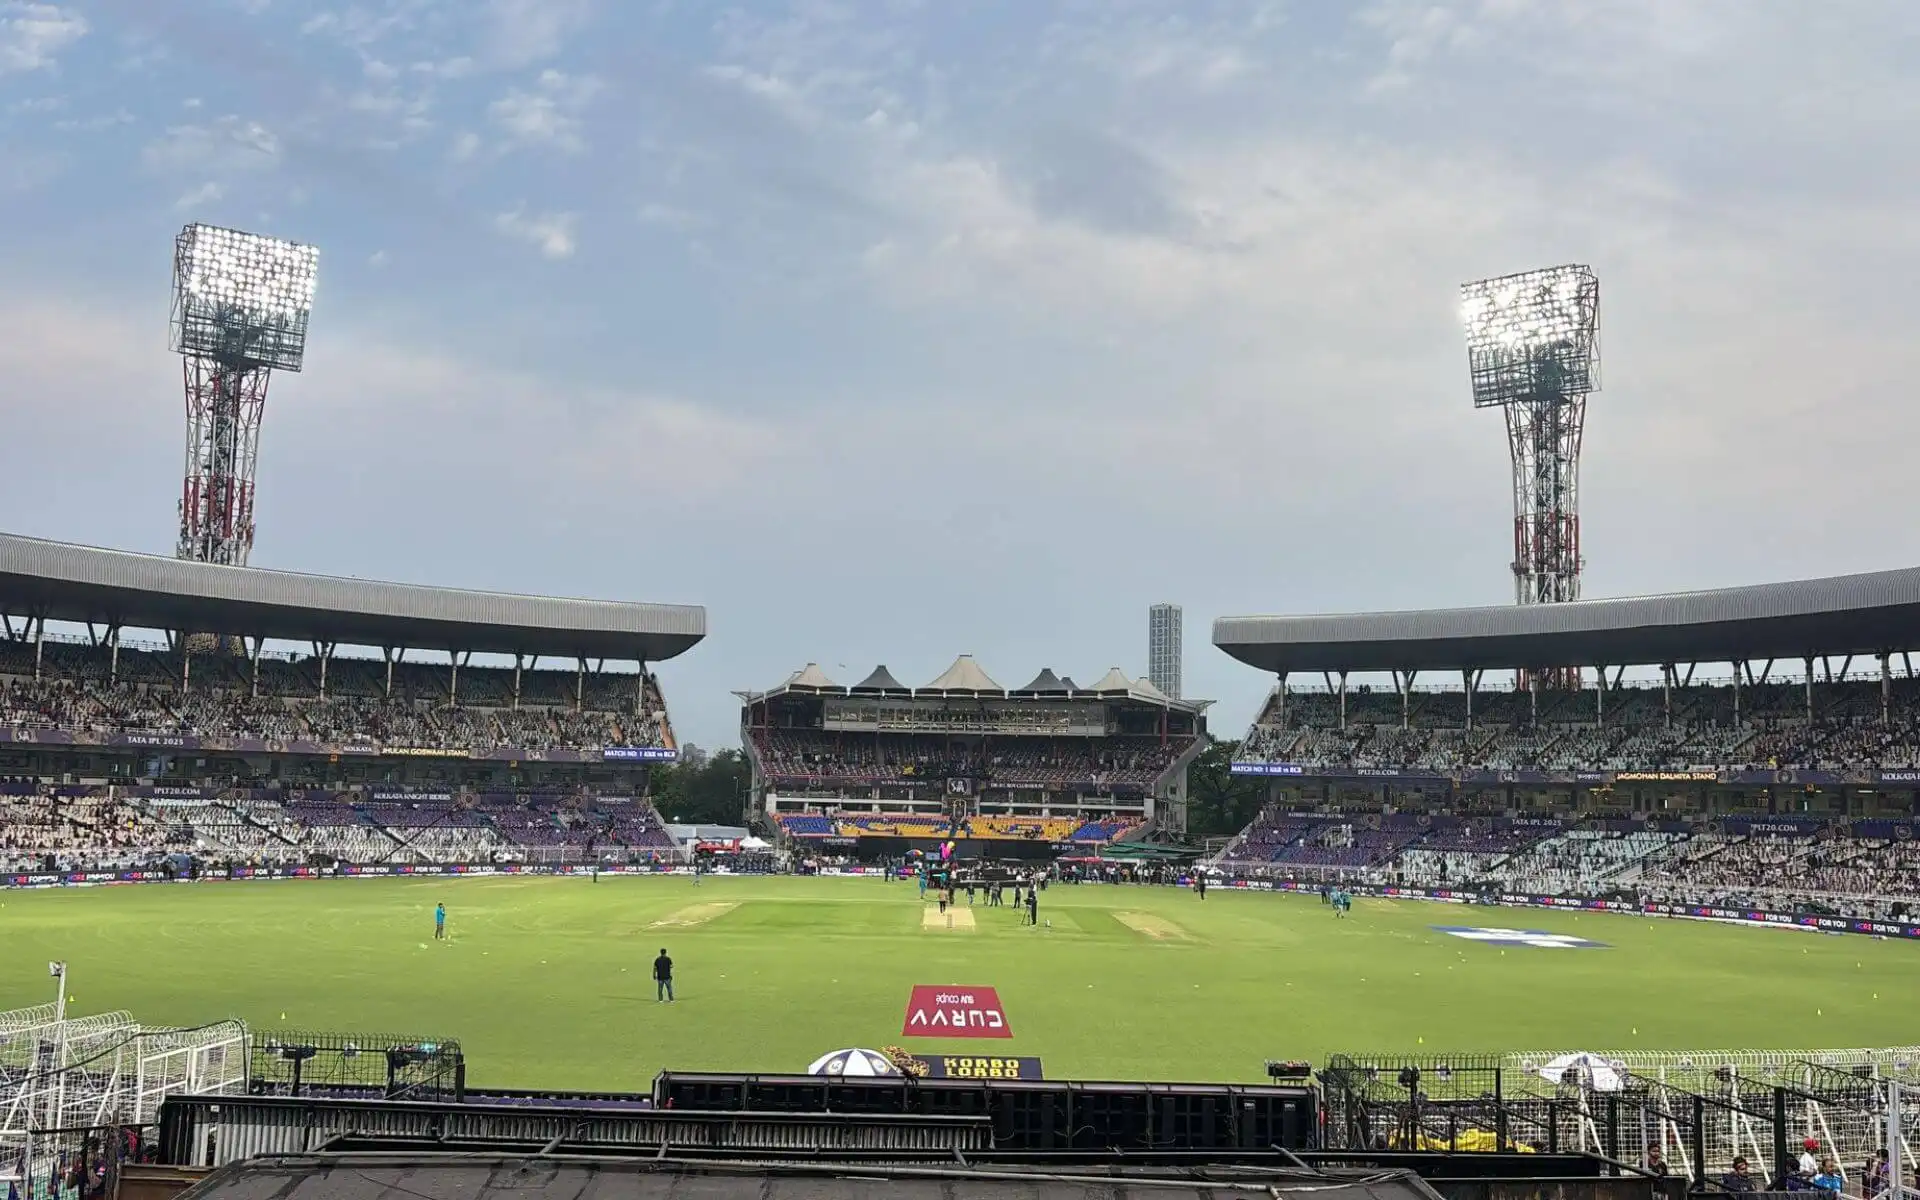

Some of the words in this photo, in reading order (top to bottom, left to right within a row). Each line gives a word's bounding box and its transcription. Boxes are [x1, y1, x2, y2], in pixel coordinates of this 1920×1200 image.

[128, 736, 147, 744] TATA
[148, 737, 161, 745] IPL
[1881, 772, 1917, 781] KOLKATA
[154, 787, 200, 795] IPLT20.COM
[1818, 919, 1832, 927] FOR
[1833, 920, 1847, 928] YOU
[1873, 924, 1886, 932] FOR
[910, 1008, 1003, 1028] CURVV
[943, 1057, 1020, 1068] KORBO
[946, 1067, 1019, 1077] LORBO
